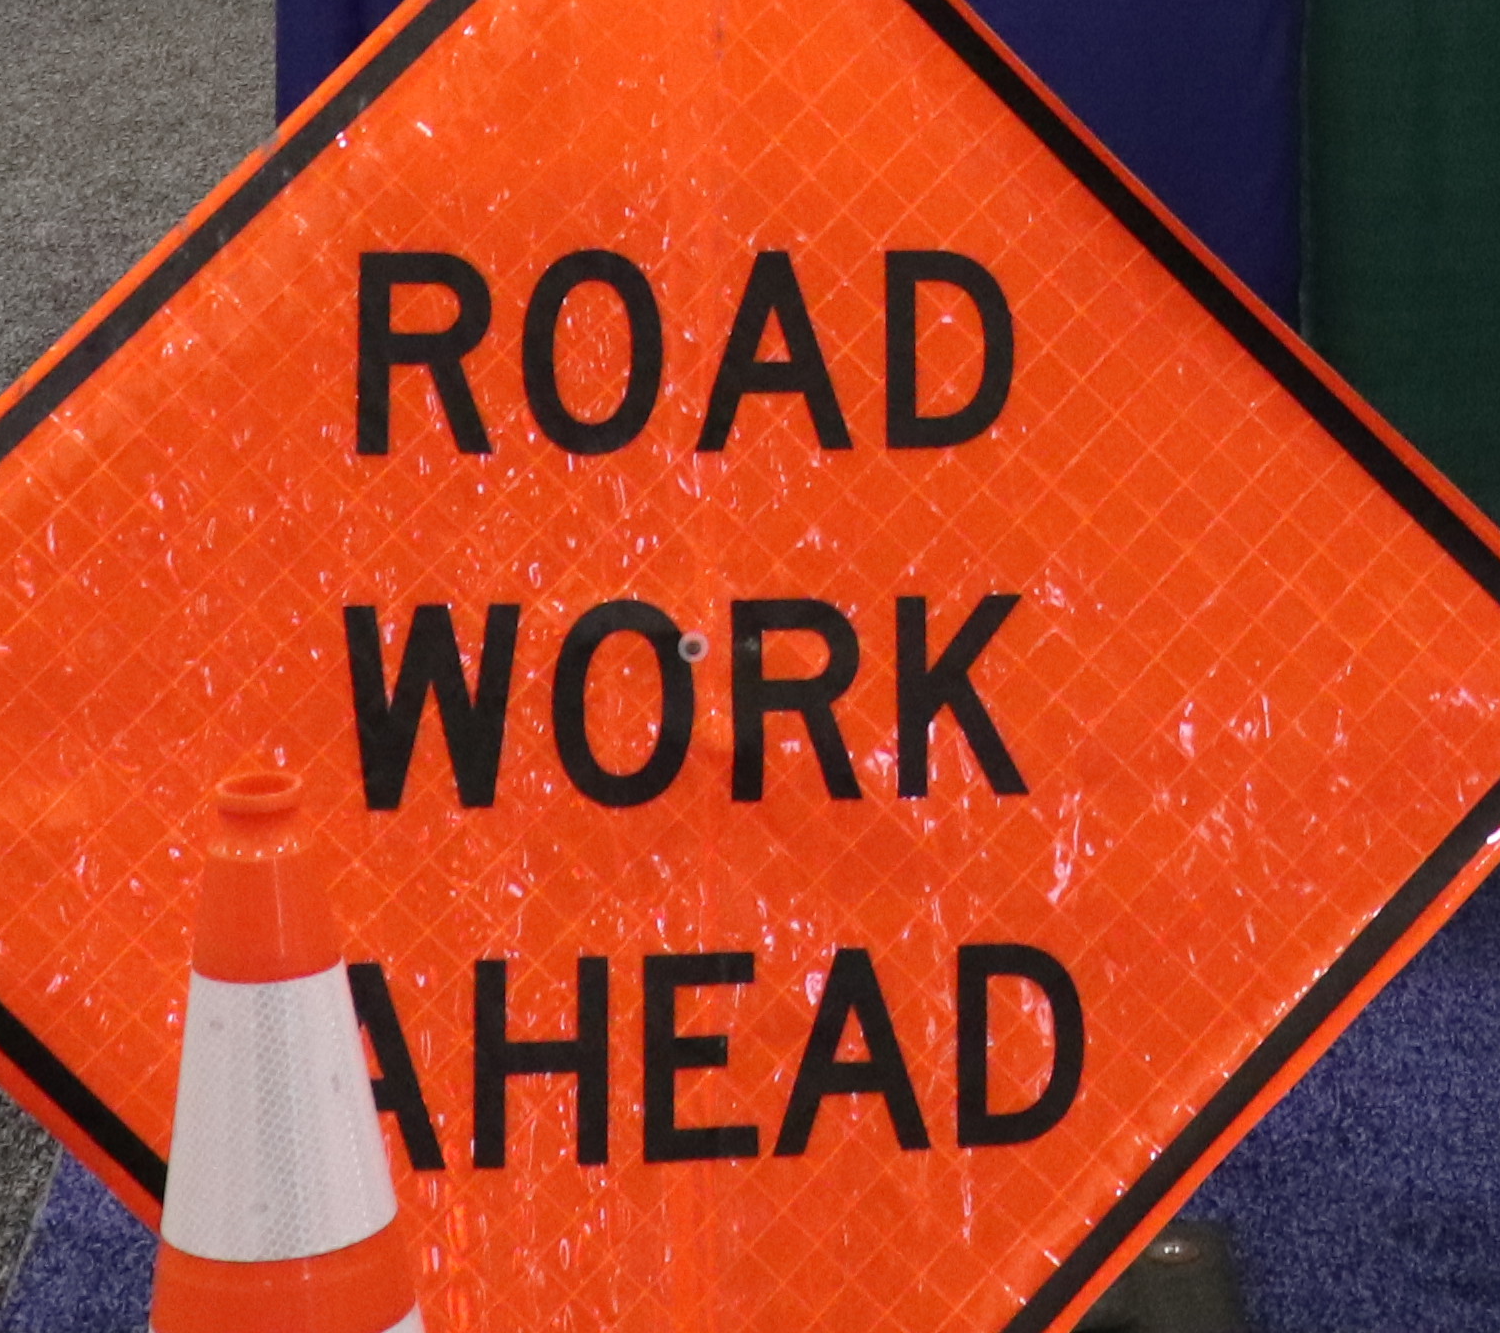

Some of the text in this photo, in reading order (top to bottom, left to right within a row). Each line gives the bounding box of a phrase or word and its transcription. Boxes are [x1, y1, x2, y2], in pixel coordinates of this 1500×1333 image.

[354, 247, 1016, 459] ROAD
[341, 591, 1031, 813] WORK
[346, 940, 1086, 1173] AHEAD
